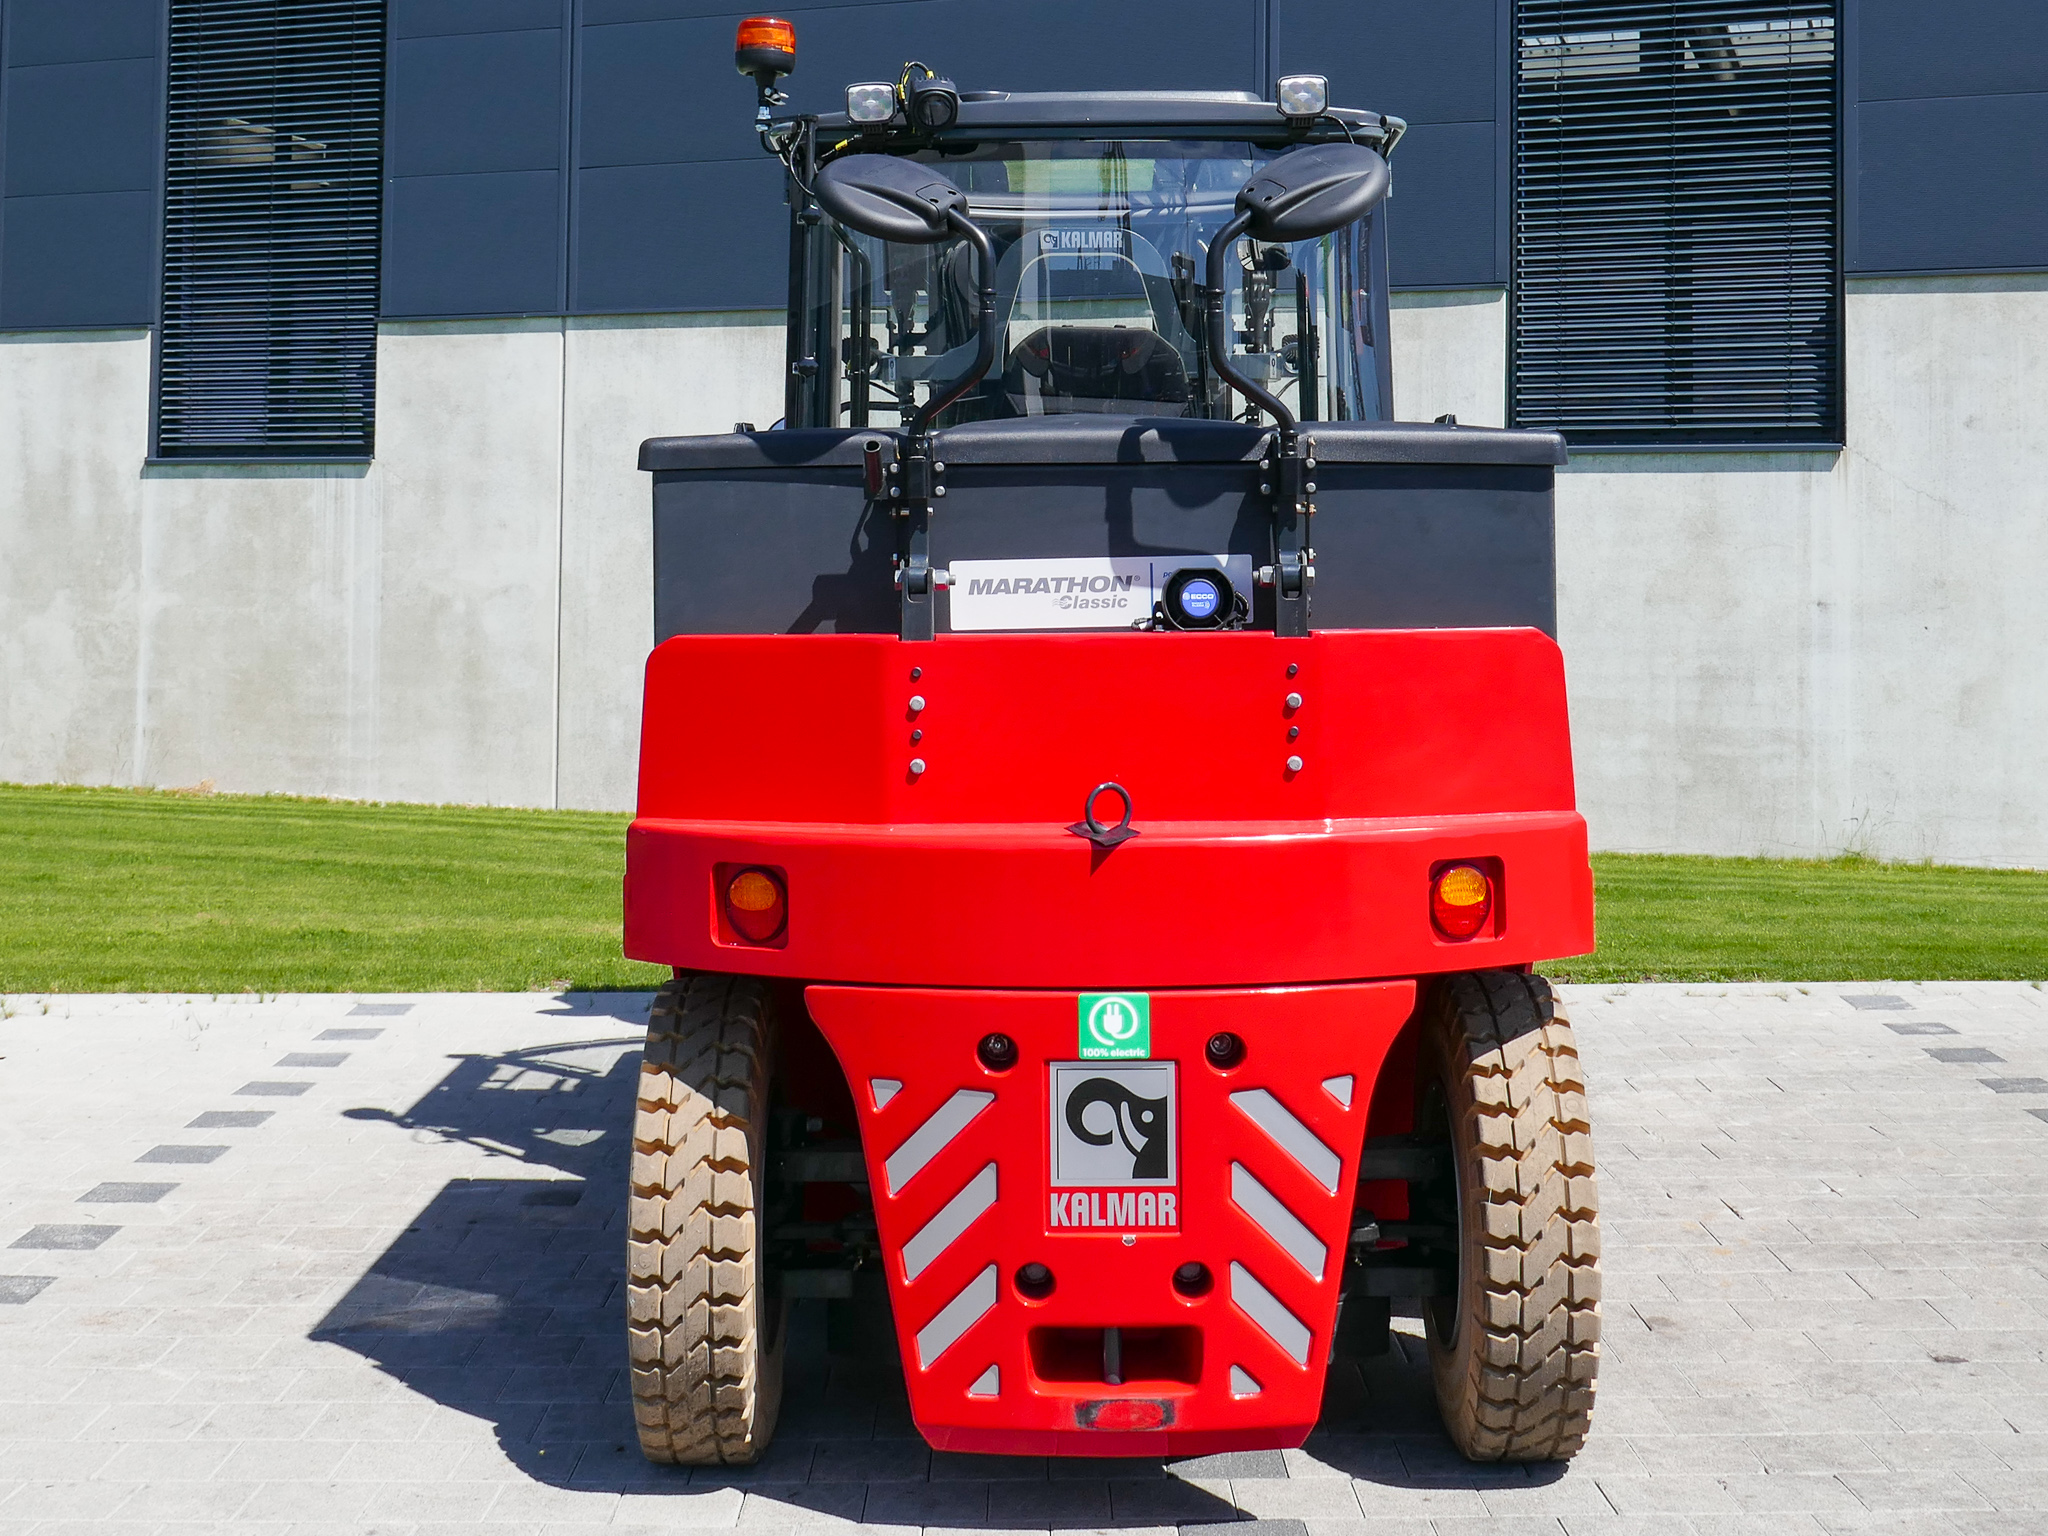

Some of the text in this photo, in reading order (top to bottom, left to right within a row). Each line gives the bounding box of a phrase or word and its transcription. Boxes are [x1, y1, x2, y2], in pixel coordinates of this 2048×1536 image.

[1061, 231, 1123, 249] KALMAR
[1060, 595, 1128, 610] Classic
[1083, 1048, 1146, 1057] 100% electric
[1050, 1191, 1177, 1227] KALMAR
